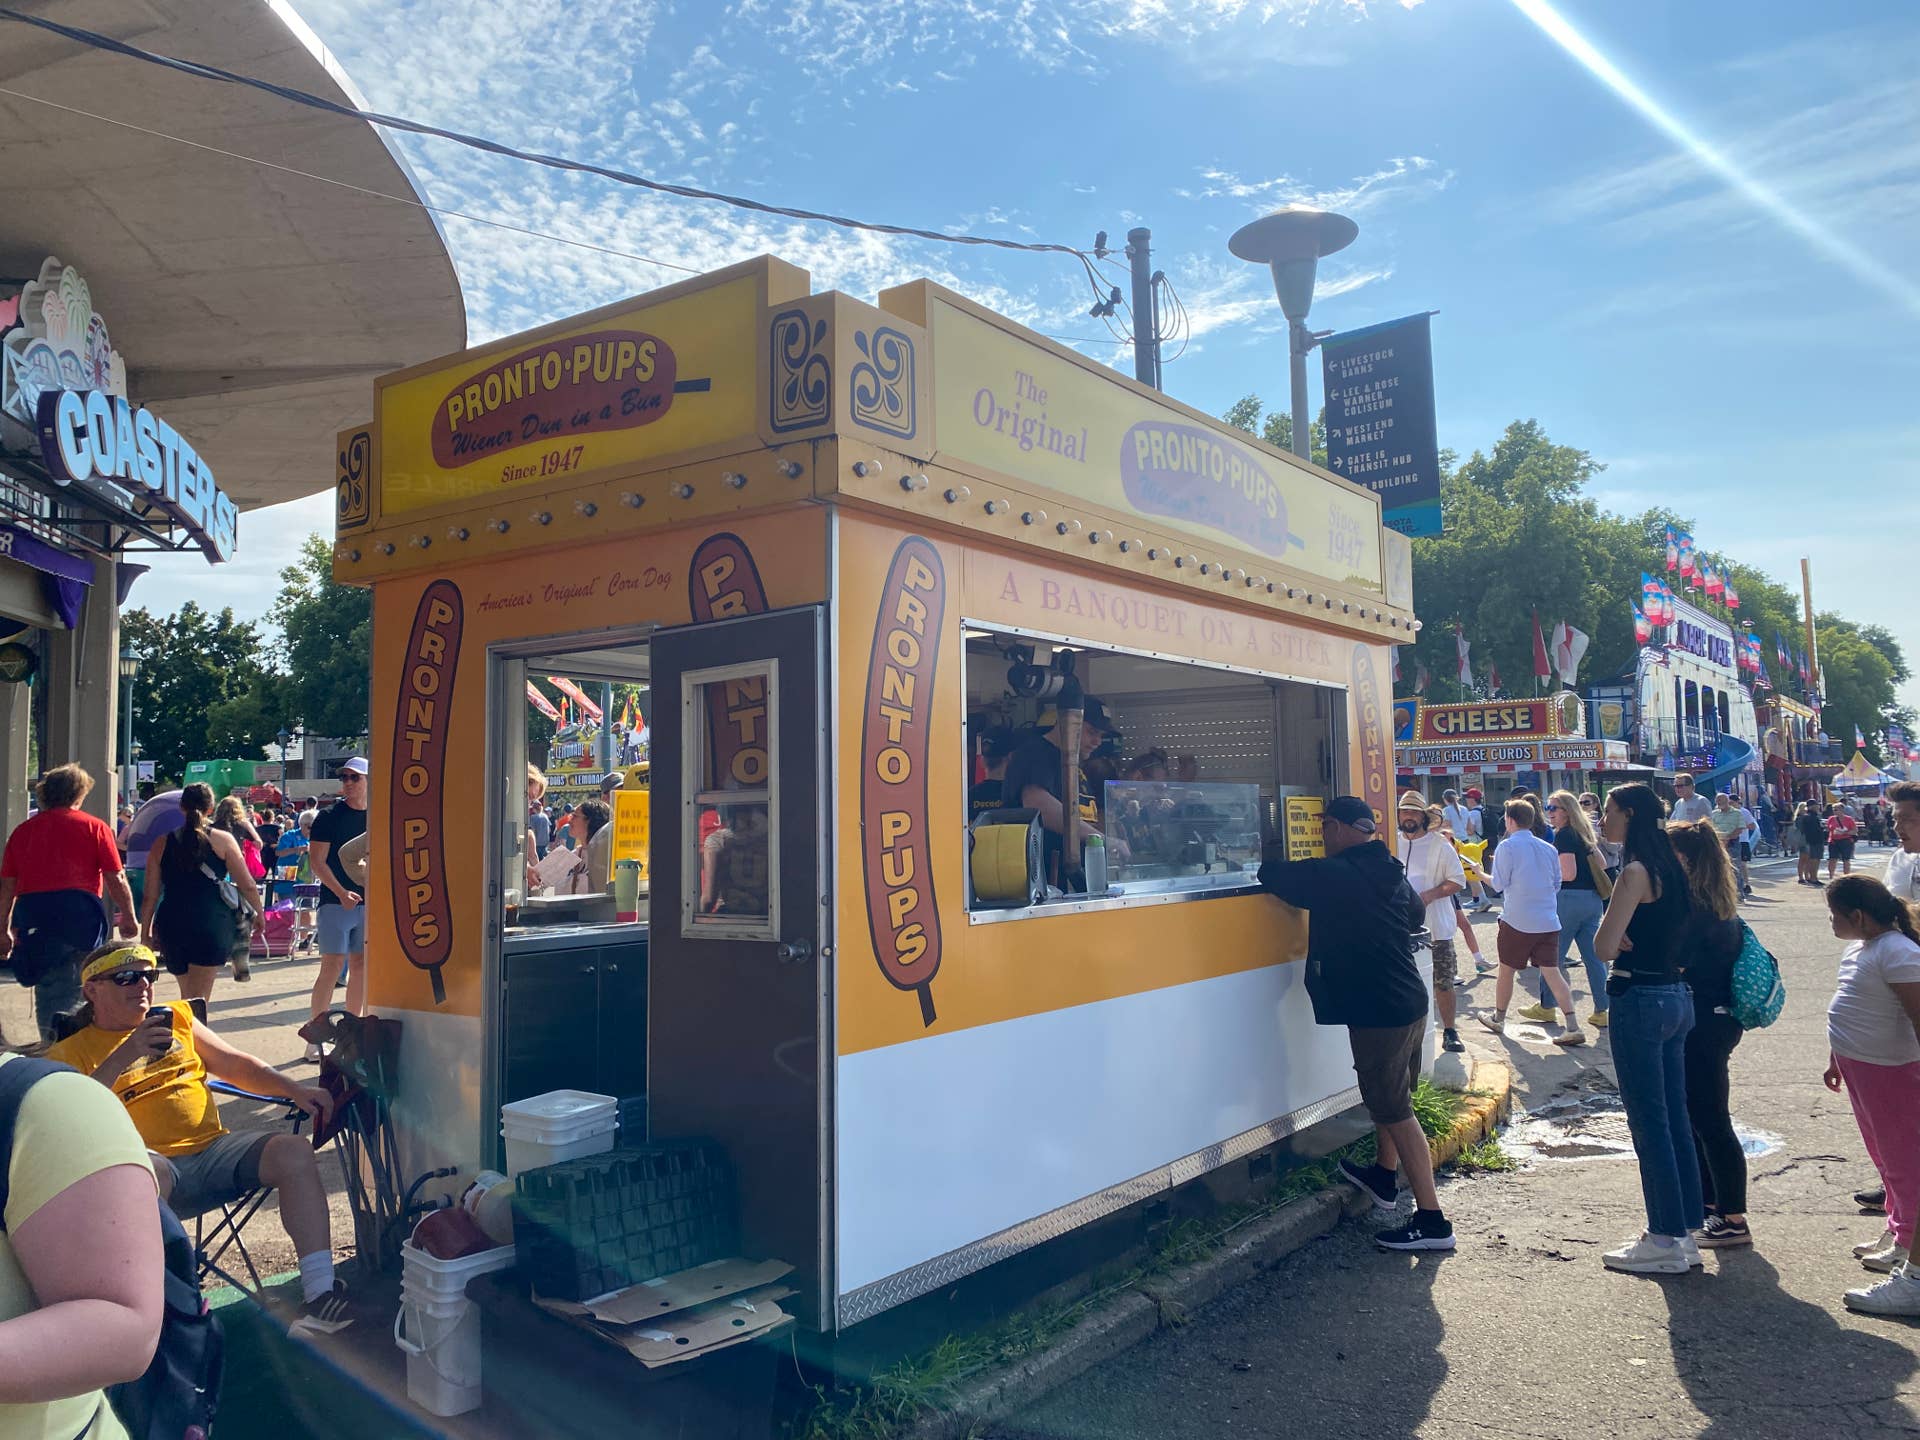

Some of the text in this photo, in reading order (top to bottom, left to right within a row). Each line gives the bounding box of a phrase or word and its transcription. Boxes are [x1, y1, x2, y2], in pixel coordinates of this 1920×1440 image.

[1341, 348, 1394, 369] LIVESTOCK
[1342, 363, 1374, 379] BARNS
[1015, 370, 1048, 406] The
[1343, 385, 1360, 398] LEE
[1375, 376, 1399, 391] ROSE
[1344, 391, 1383, 407] WARNER
[1344, 398, 1393, 417] COLISEUM
[452, 387, 662, 456] Wiener Dun in a Bun
[973, 387, 1088, 463] Original
[1345, 418, 1394, 436] WEST END
[1346, 430, 1385, 447] MARKET
[502, 445, 585, 483] Since 1947
[1347, 453, 1371, 466] GATE
[1348, 454, 1412, 475] TRANSIT HUB
[56, 389, 235, 564] COASTERS
[1371, 473, 1419, 490] BUILDING
[607, 571, 640, 597] Corn
[644, 566, 673, 592] Dog
[1000, 571, 1332, 666] A BANQUET ON A STICK
[876, 554, 936, 785] PRONTO
[402, 598, 454, 797] PRONTO
[1357, 657, 1382, 793] PRONTO
[1431, 707, 1532, 733] CHEESE
[1443, 747, 1532, 762] CHEESE CURDS
[1547, 750, 1600, 759] LEMONADE
[402, 818, 440, 950] PUPS
[880, 810, 929, 967] PUPS
